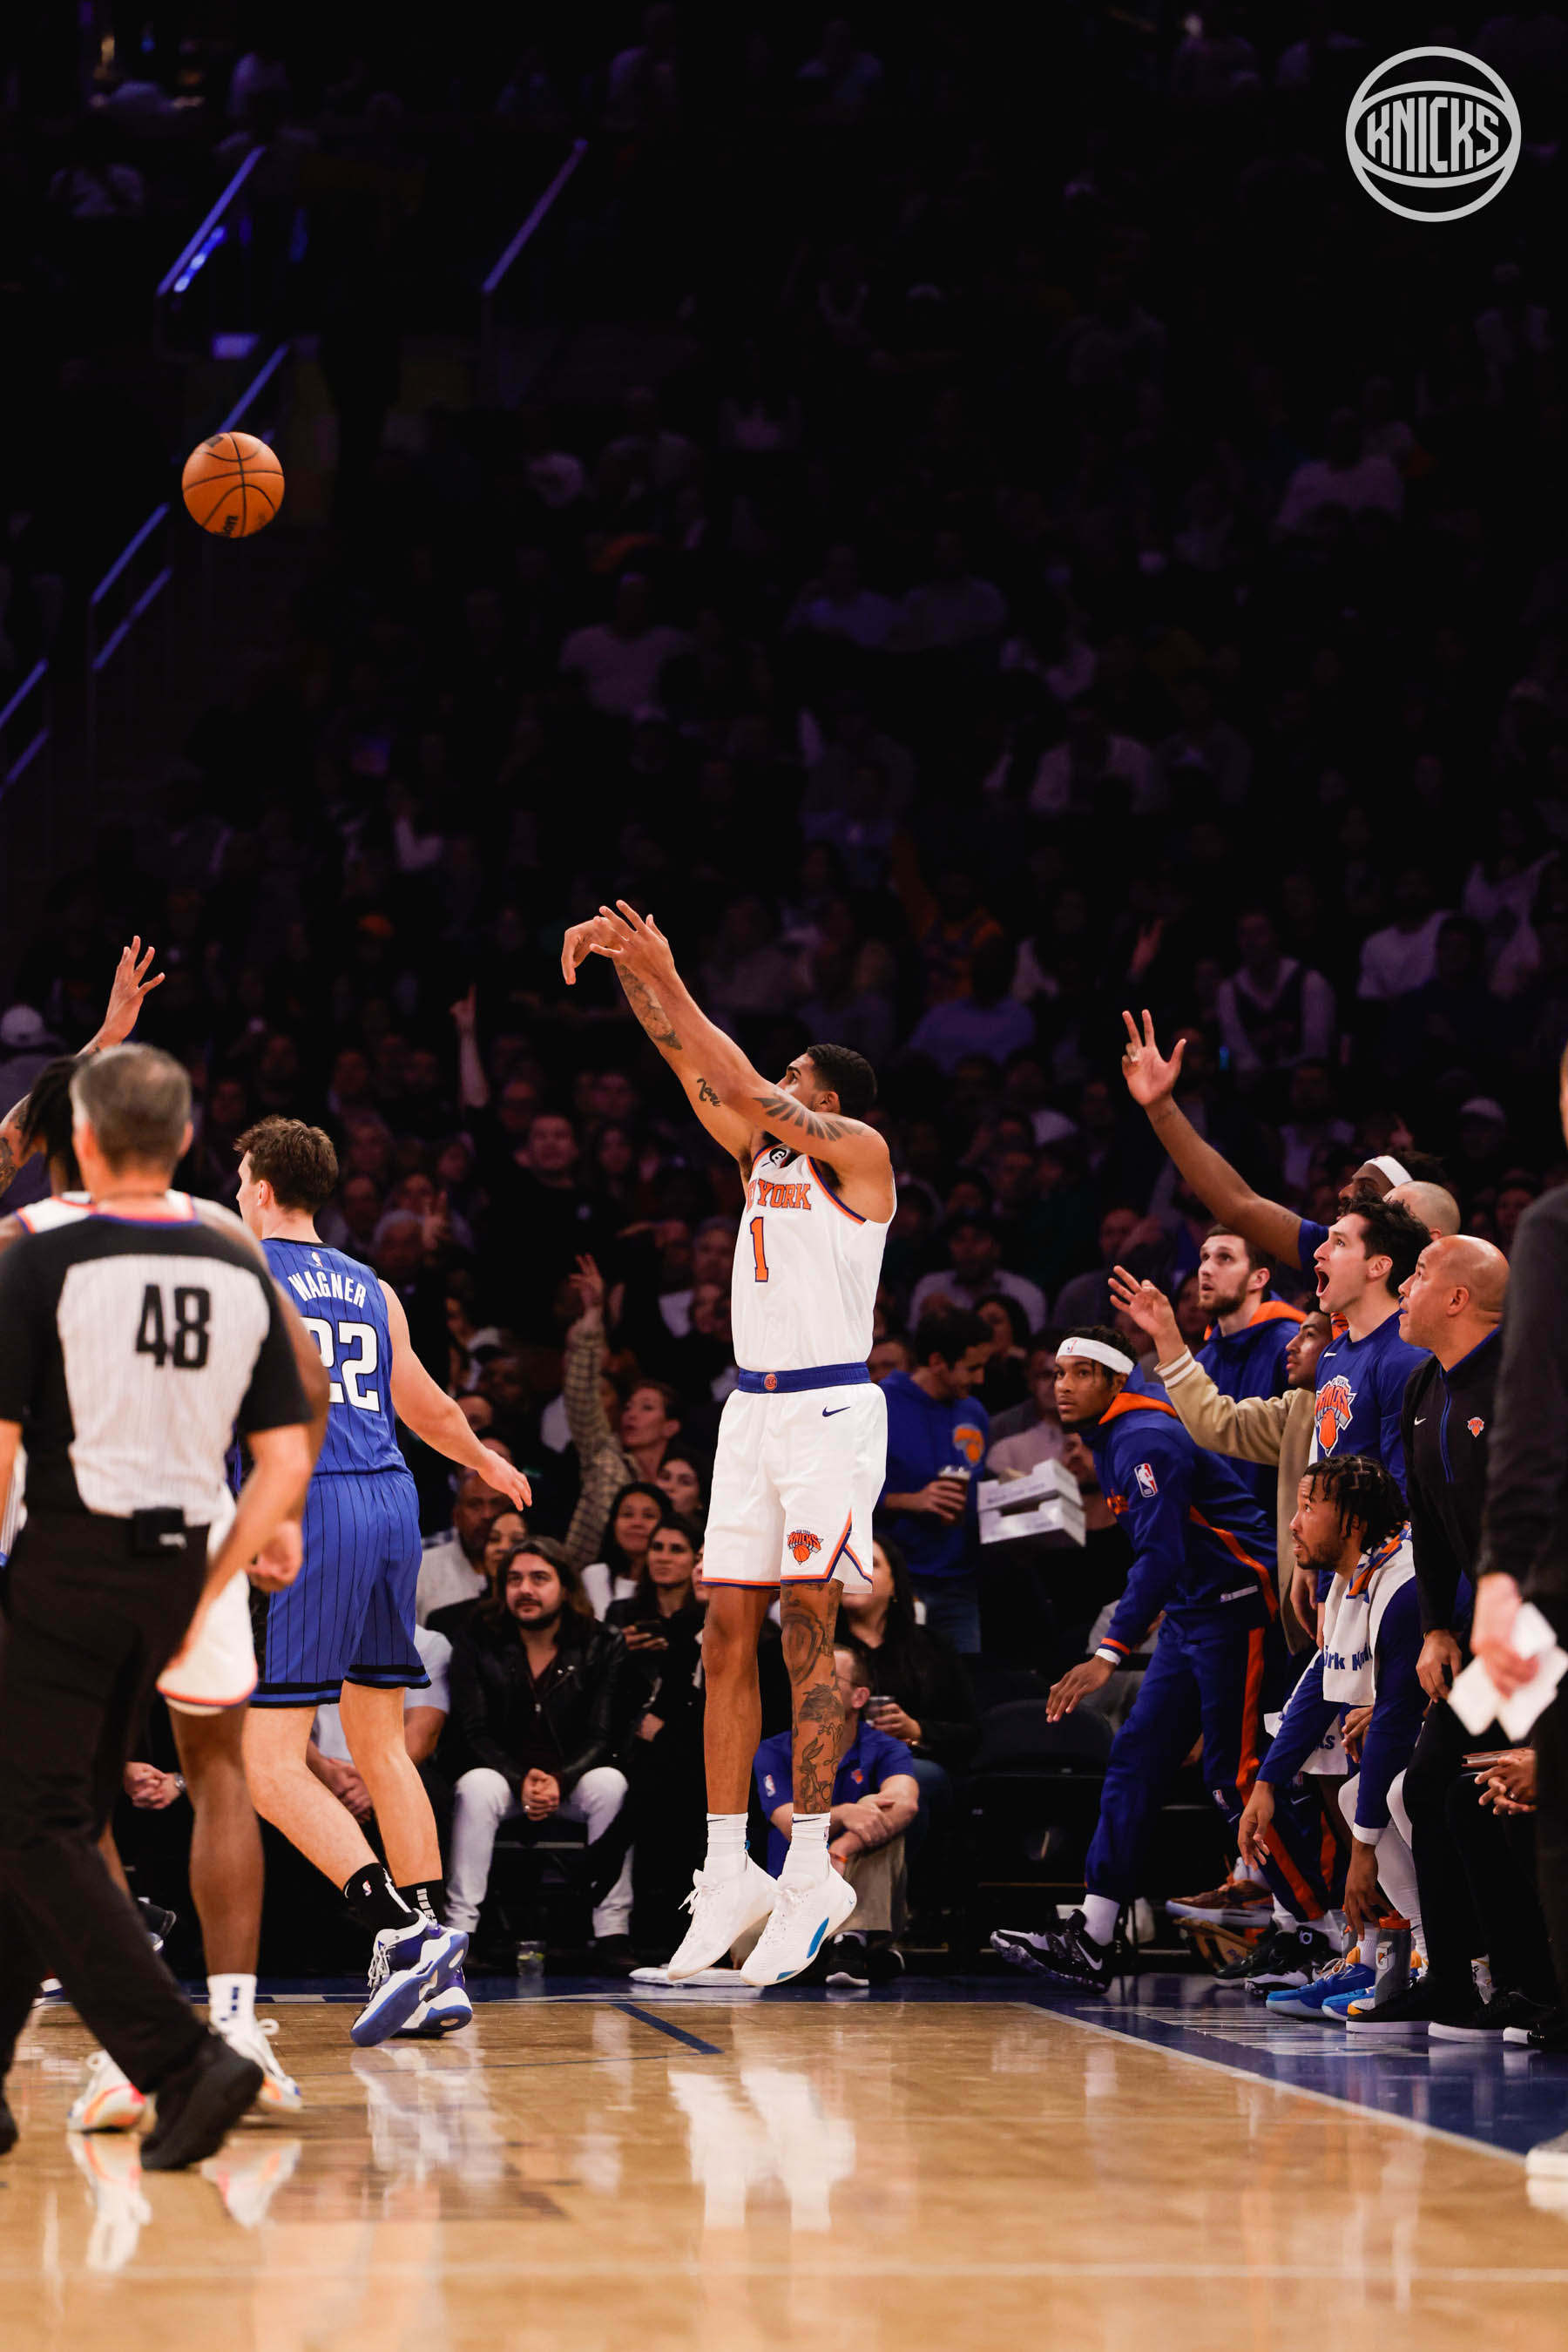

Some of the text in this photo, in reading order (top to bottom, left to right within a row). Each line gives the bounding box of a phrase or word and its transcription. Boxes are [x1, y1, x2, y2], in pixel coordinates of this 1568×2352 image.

[757, 1179, 812, 1211] YORK
[749, 1216, 769, 1283] 1
[287, 1271, 367, 1308] WAGNER
[135, 1284, 211, 1369] 48
[787, 1531, 821, 1551] KNICKS
